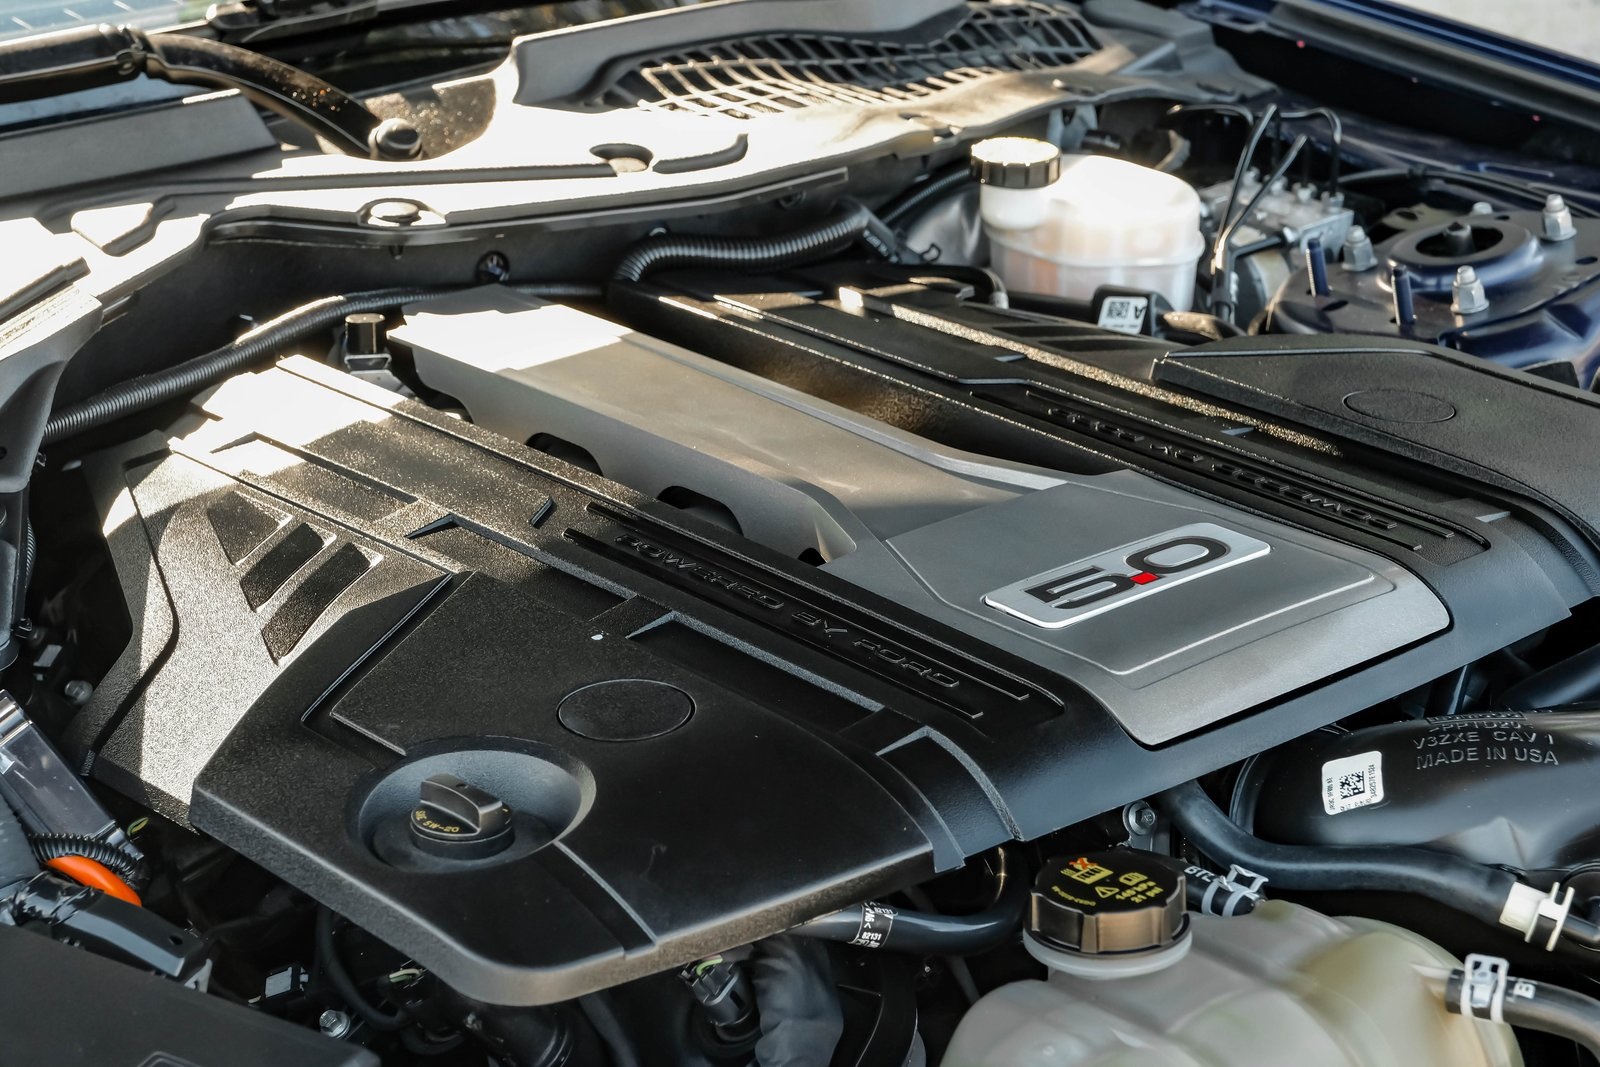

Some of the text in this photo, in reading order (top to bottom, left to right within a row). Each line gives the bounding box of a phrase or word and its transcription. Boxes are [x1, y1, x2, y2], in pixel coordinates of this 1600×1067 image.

[1023, 536, 1231, 609] 5.0
[791, 611, 848, 635] BY
[852, 639, 960, 688] FORD
[1416, 746, 1560, 770] MADE IN USA
[422, 820, 460, 833] 5W-20
[861, 931, 882, 941] 82131
